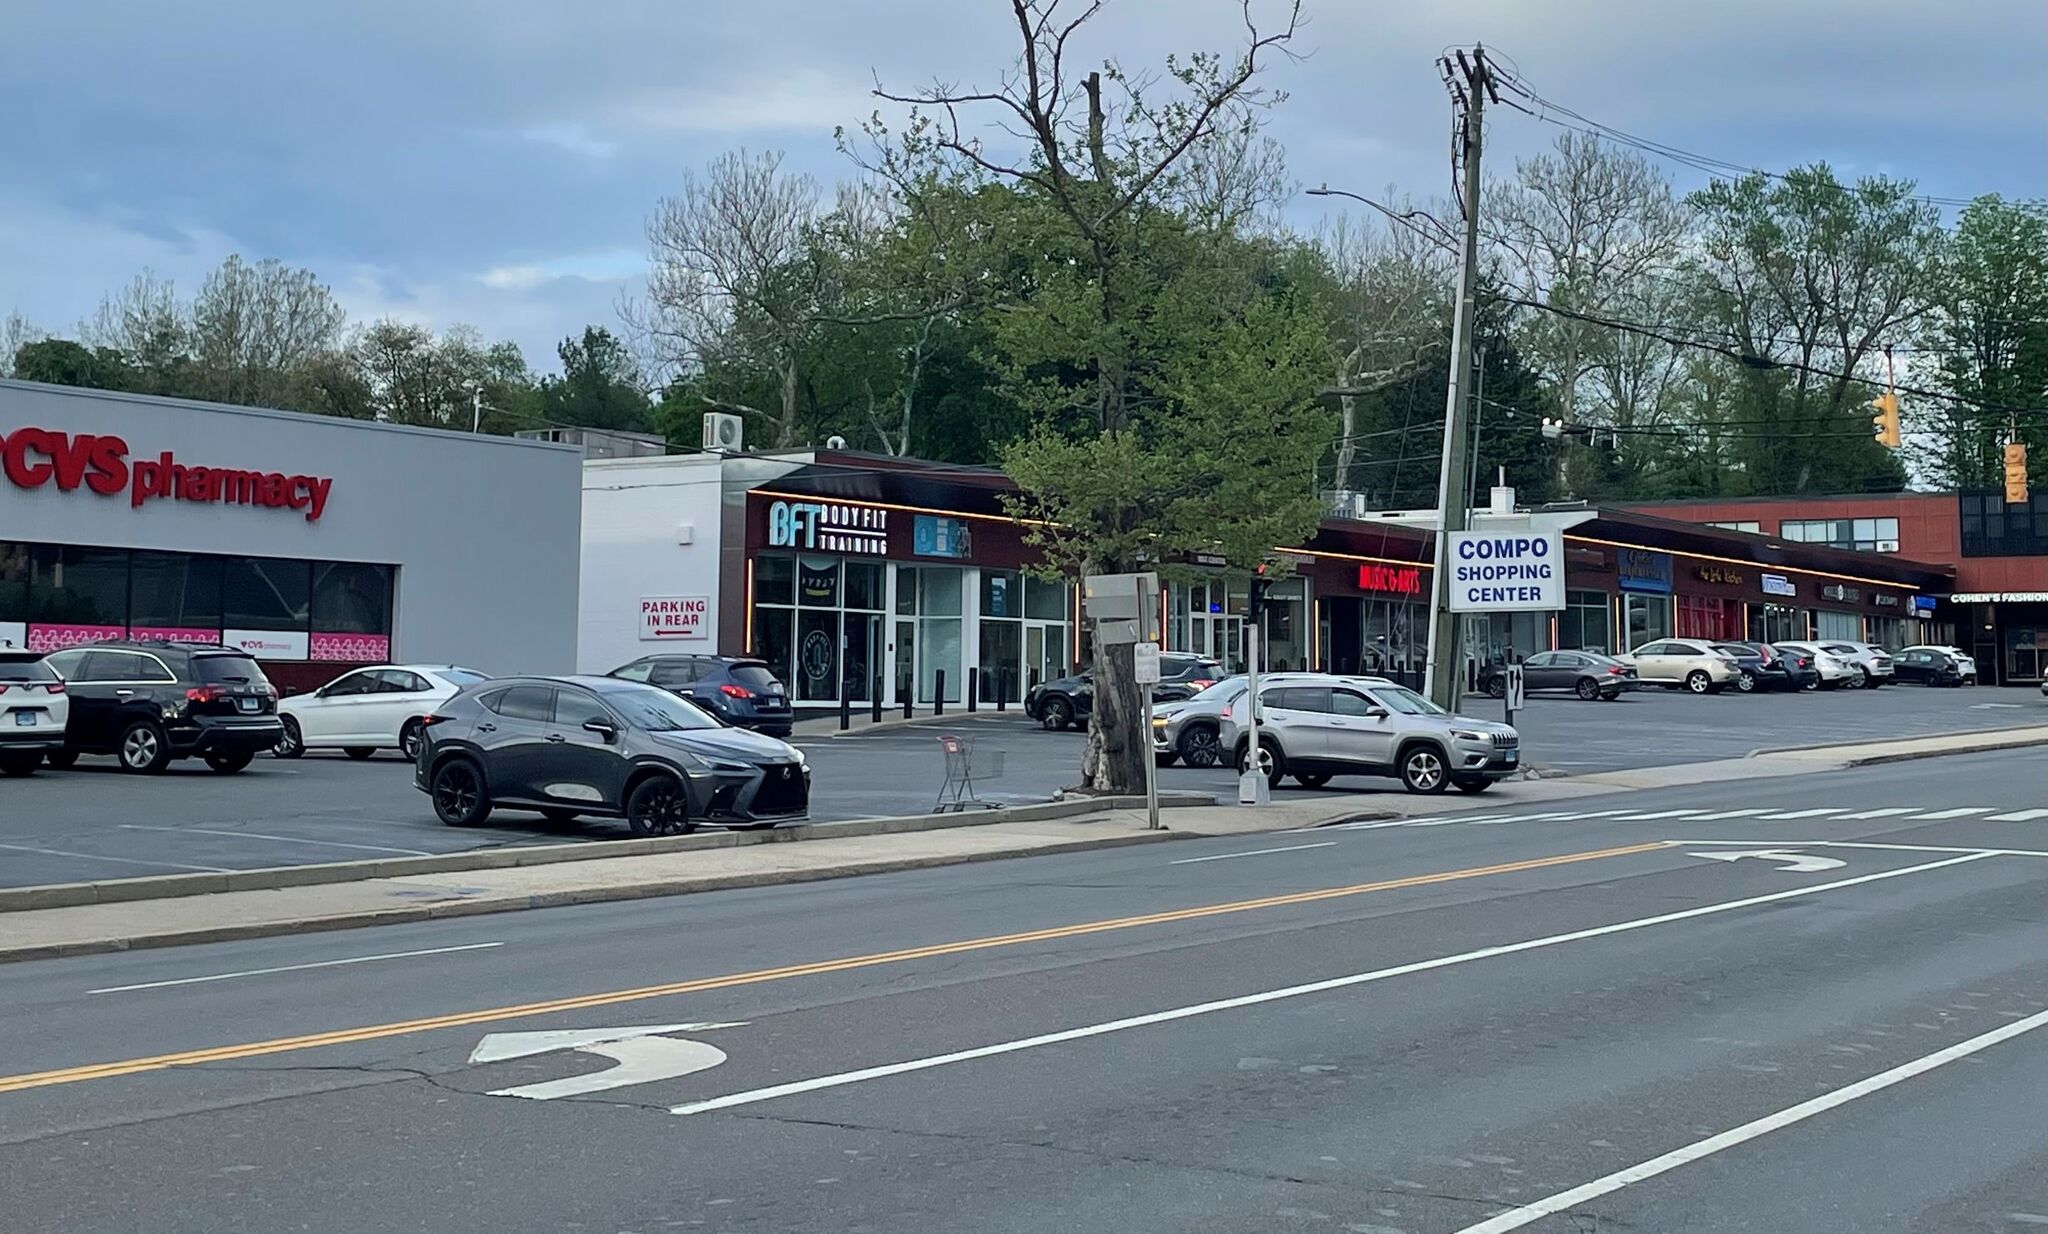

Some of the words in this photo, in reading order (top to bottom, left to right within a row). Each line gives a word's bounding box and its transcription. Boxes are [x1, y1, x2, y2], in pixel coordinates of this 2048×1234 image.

[3, 427, 129, 494] CVS
[131, 451, 333, 521] pharmacy
[769, 501, 820, 548] BFT
[821, 504, 859, 527] BODY
[863, 509, 887, 529] FIT
[820, 534, 888, 555] TRAINING
[1459, 538, 1548, 560] COMPO
[1359, 565, 1388, 591] MUSIC
[1398, 569, 1421, 593] ARTS
[1457, 564, 1552, 581] SHOPPING
[1468, 587, 1541, 602] CENTER
[1951, 593, 2001, 604] COHEN'S
[2001, 592, 2048, 603] FASHION
[642, 601, 705, 613] PARKING
[647, 615, 660, 626] IN
[665, 614, 699, 626] REAR
[248, 640, 264, 649] CVS
